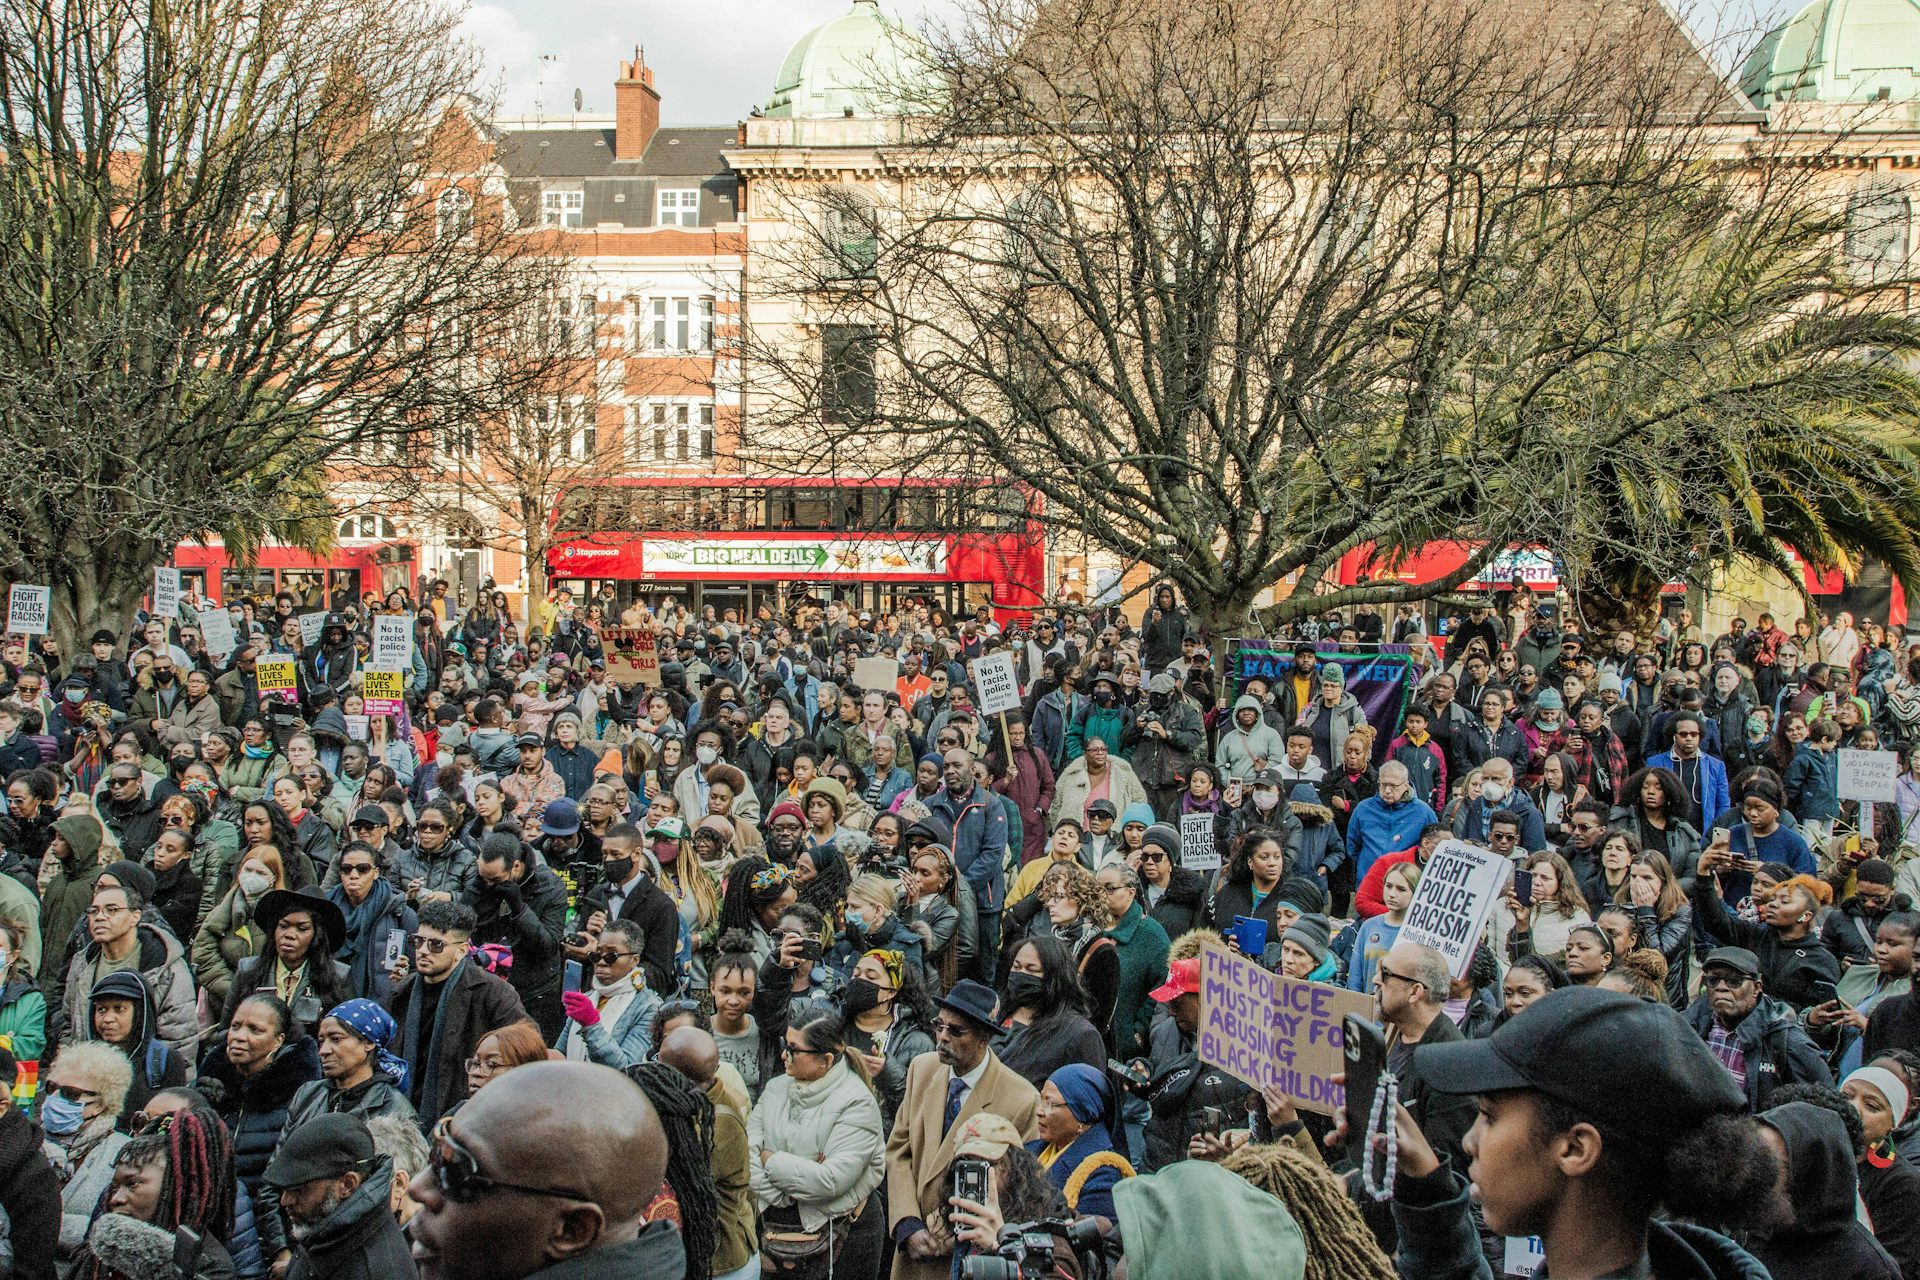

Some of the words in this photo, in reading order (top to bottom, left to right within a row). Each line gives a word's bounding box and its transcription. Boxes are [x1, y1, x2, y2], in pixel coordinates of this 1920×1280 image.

[576, 549, 619, 557] Stagecoach
[695, 549, 730, 564] BIG
[731, 549, 769, 564] MEAL
[770, 549, 816, 564] DEALS
[159, 576, 166, 584] No
[13, 591, 39, 601] FIGHT
[12, 602, 44, 612] POLICE
[12, 611, 45, 622] RACISM
[380, 634, 406, 642] racist
[601, 630, 622, 641] LET
[625, 630, 654, 642] BLACK
[380, 643, 406, 651] police
[608, 653, 618, 664] BE
[631, 658, 656, 669] GIRLS
[259, 663, 286, 672] BLACK
[980, 667, 992, 676] No
[1357, 664, 1404, 682] NEU
[260, 672, 282, 680] LIVES
[366, 672, 394, 680] BLACK
[983, 672, 1008, 686] racist
[260, 680, 294, 688] MATTER
[366, 681, 390, 689] LIVES
[366, 690, 400, 698] MATTER
[984, 684, 1010, 697] police
[987, 694, 1004, 702] Justice
[1853, 768, 1889, 779] BLACK
[1182, 821, 1207, 833] FIGHT
[1183, 832, 1214, 845] POLICE
[1184, 844, 1218, 856] RACISM
[1444, 846, 1466, 859] Socialist
[1464, 852, 1487, 866] Worker
[1427, 854, 1476, 887] FIGHT
[1418, 878, 1476, 918] POLICE
[1407, 902, 1471, 944] RACISM
[1402, 928, 1426, 946] Abolish
[1426, 936, 1441, 950] the
[1442, 941, 1460, 958] Met
[1206, 950, 1244, 987] THE
[1248, 967, 1334, 1018] POLICE
[1206, 978, 1260, 1020] MUST
[1264, 1005, 1303, 1037] PAY
[1309, 1020, 1344, 1048] FO
[1209, 1006, 1297, 1067] ABUSING
[1202, 1032, 1260, 1084] BLACK
[1262, 1062, 1346, 1108] CHILDRE
[1760, 1062, 1776, 1072] HH
